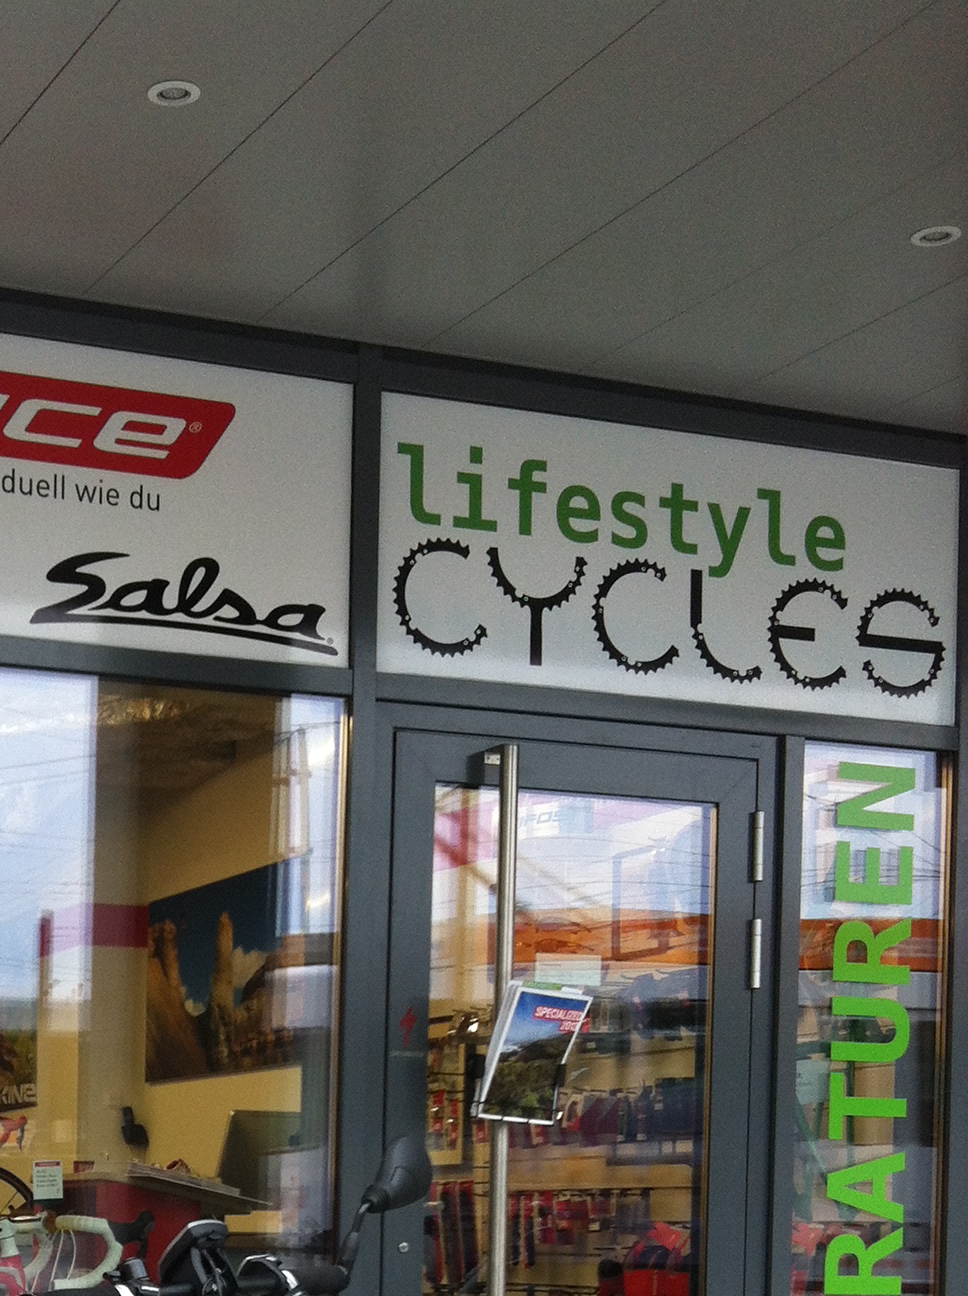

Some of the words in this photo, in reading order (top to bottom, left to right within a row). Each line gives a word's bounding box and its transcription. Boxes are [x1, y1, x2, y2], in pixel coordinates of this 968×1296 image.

[76, 482, 120, 507] wie
[130, 488, 161, 512] du
[398, 442, 846, 578] lifestyle
[29, 552, 338, 656] Salsa
[393, 538, 946, 698] CYCLES
